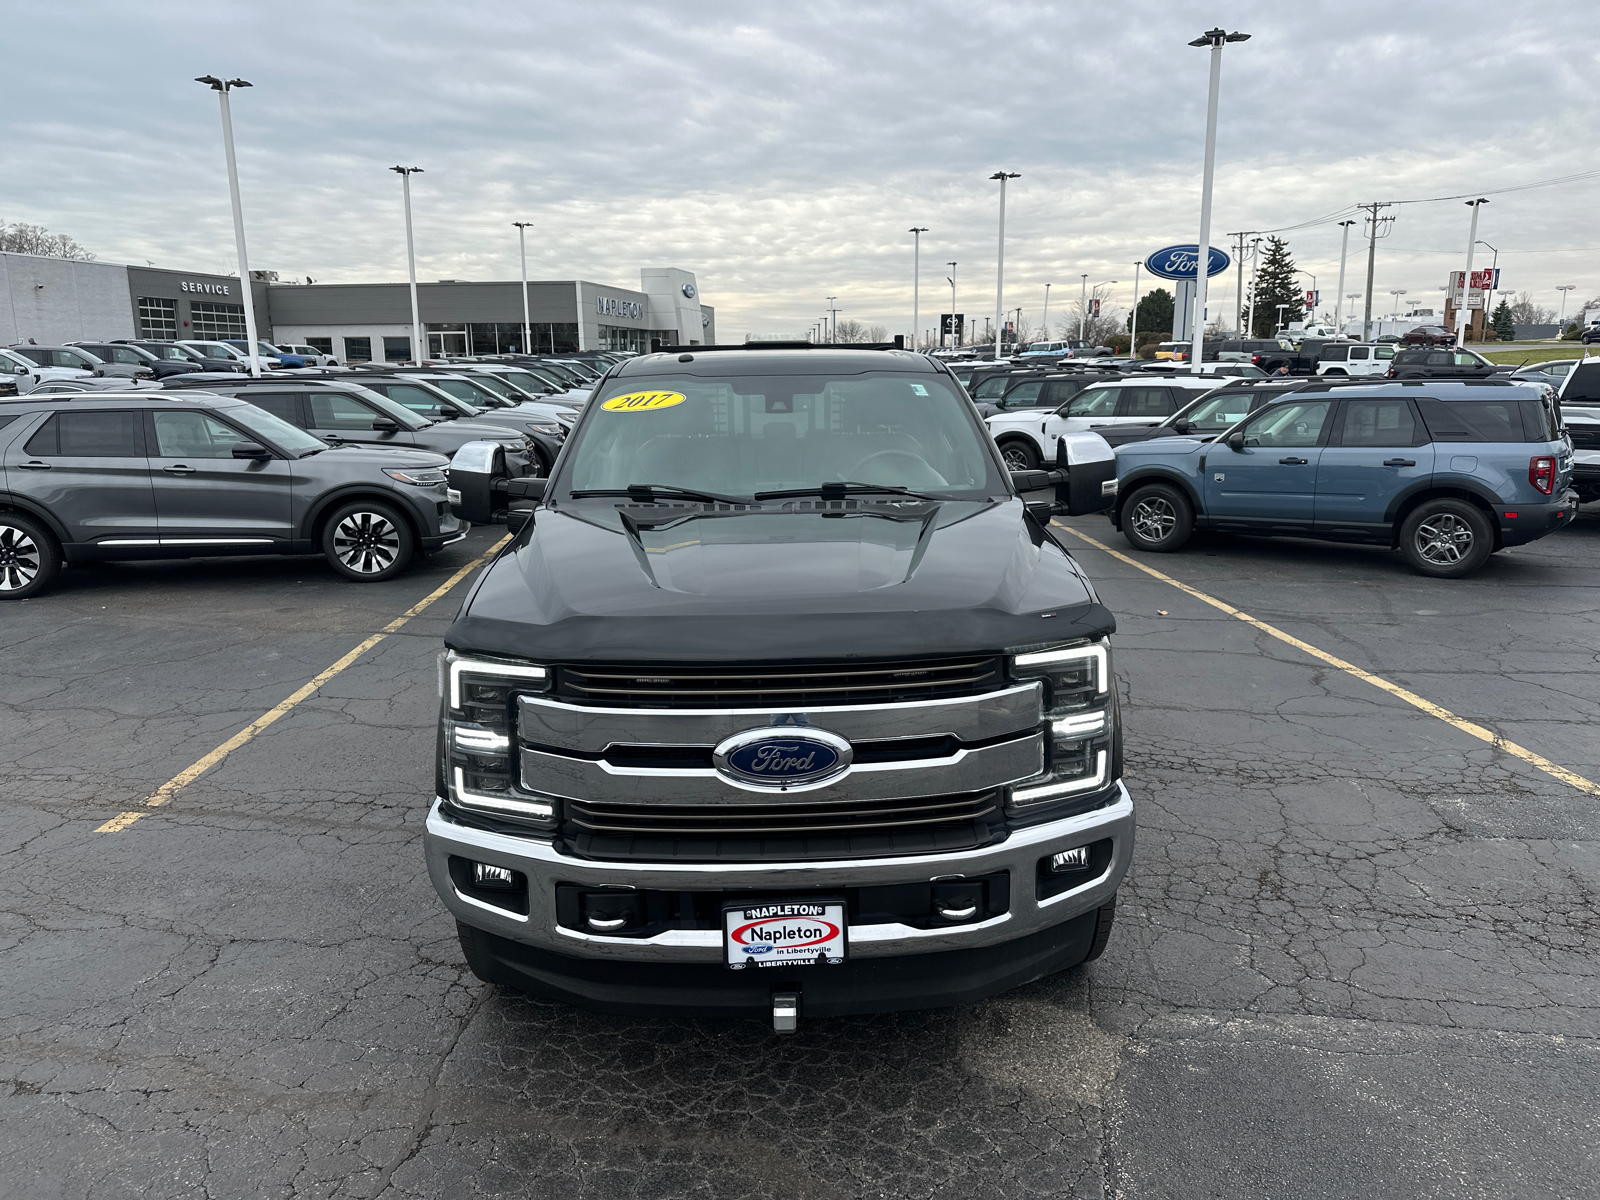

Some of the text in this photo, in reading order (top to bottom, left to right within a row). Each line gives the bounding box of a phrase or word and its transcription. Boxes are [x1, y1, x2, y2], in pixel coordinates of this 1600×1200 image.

[181, 281, 230, 295] SERVICE
[597, 296, 644, 320] NAPLETON
[612, 393, 674, 410] 2017
[751, 745, 816, 772] Ford
[751, 904, 818, 919] NAPLETON
[750, 925, 823, 944] Napleton
[748, 945, 768, 953] Ford
[786, 946, 832, 955] Libertyville
[758, 959, 816, 968] LIBERTYVILLE
